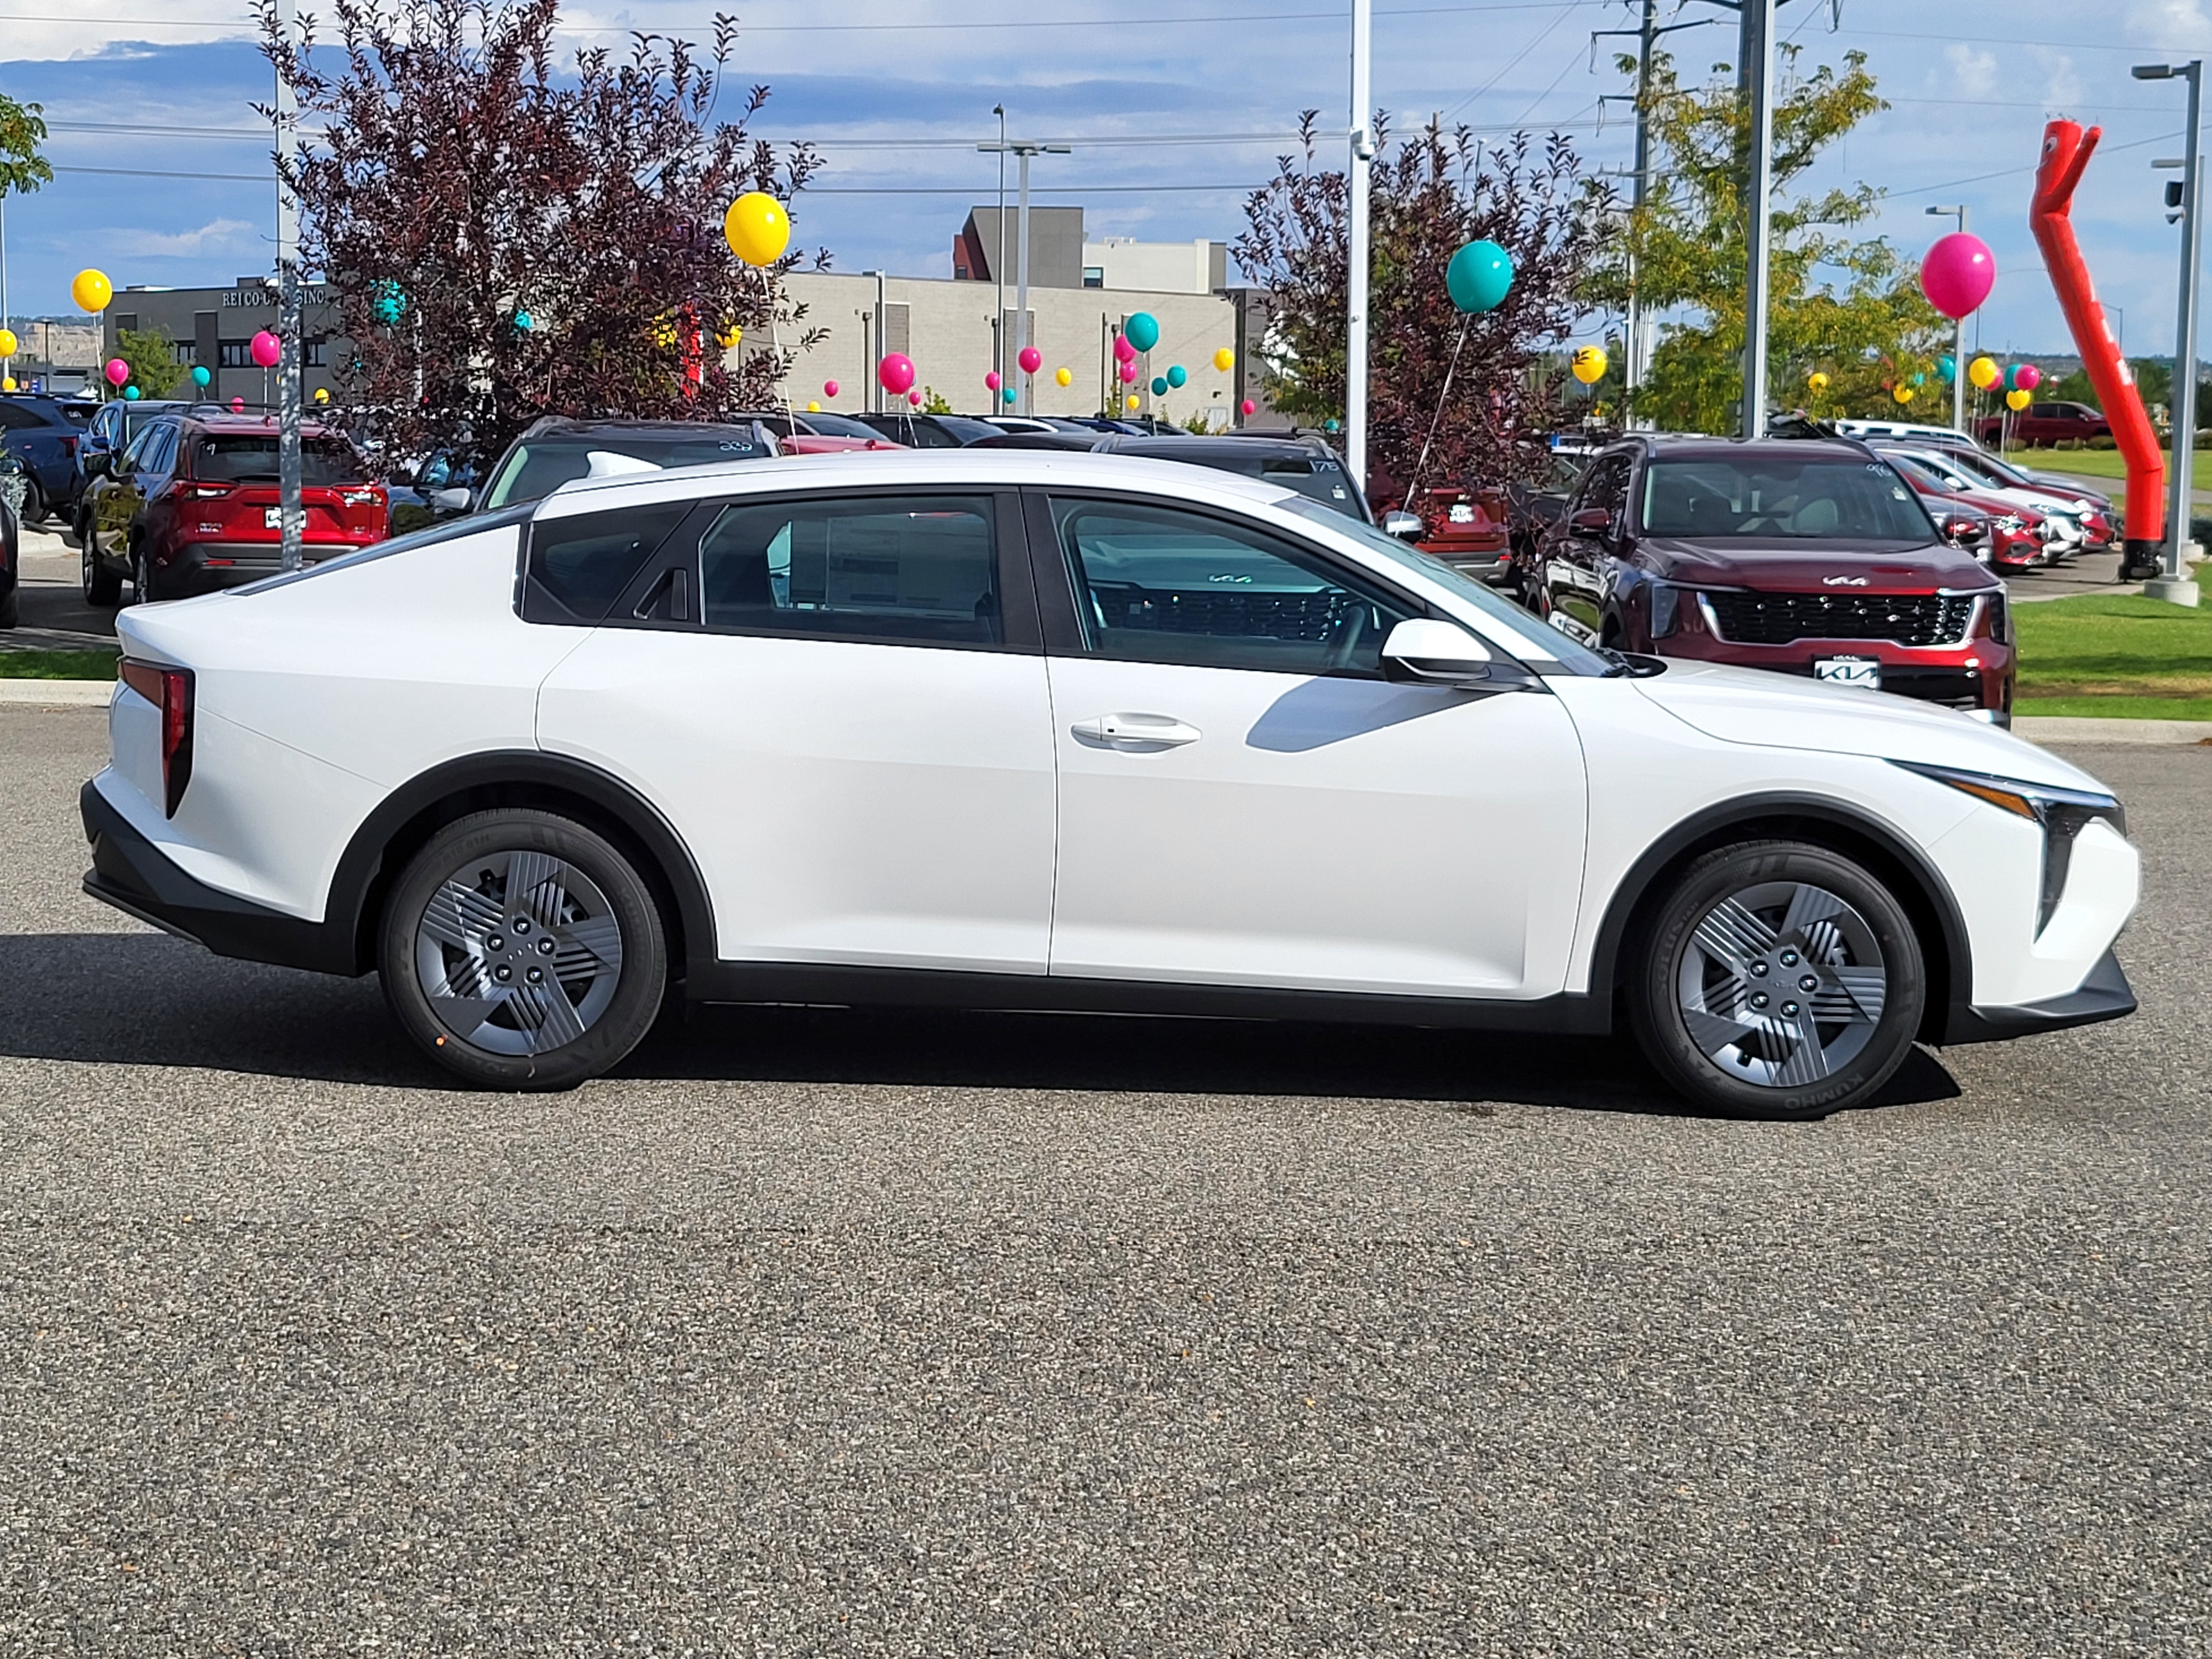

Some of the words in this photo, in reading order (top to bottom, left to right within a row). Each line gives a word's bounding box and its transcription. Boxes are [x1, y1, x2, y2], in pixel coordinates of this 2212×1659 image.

[1822, 576, 1870, 587] KIA
[1815, 665, 1877, 680] KIA
[1783, 1073, 1865, 1110] KUMHO
